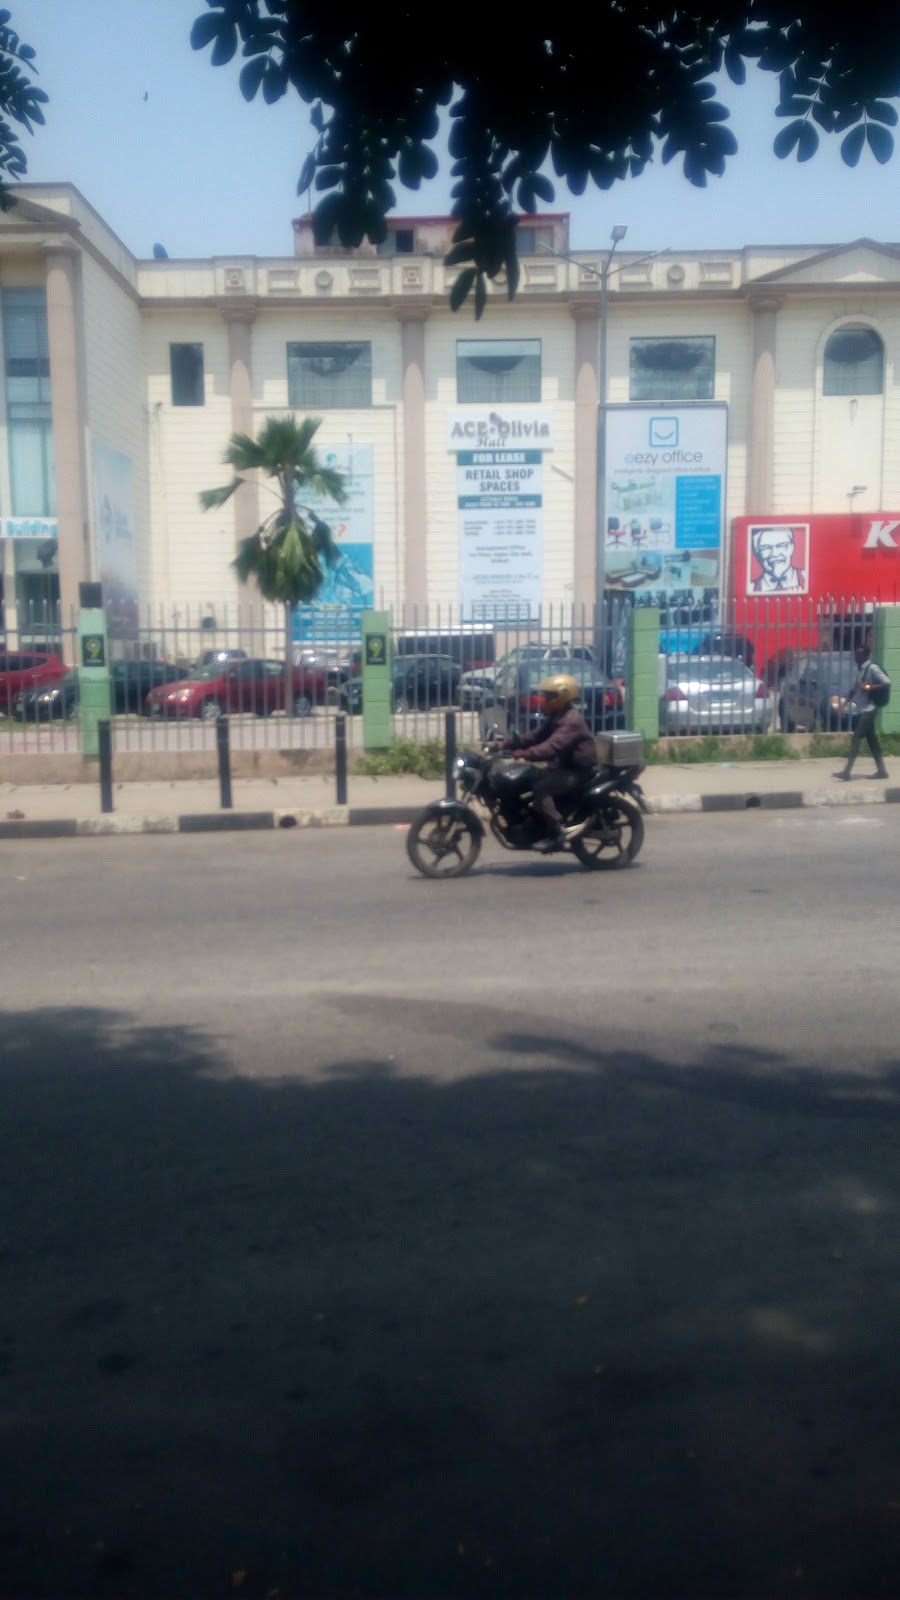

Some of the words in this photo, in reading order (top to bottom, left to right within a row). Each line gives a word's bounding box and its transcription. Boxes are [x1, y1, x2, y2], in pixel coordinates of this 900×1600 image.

[451, 421, 487, 438] ACE
[475, 436, 508, 447] Hall
[473, 452, 493, 463] FOR
[495, 452, 525, 462] LEASE
[624, 452, 659, 465] eezy
[662, 450, 704, 463] office
[465, 469, 501, 480] RETAIL
[505, 468, 534, 479] SHOP
[480, 481, 520, 492] SPACES
[863, 520, 900, 548] K
